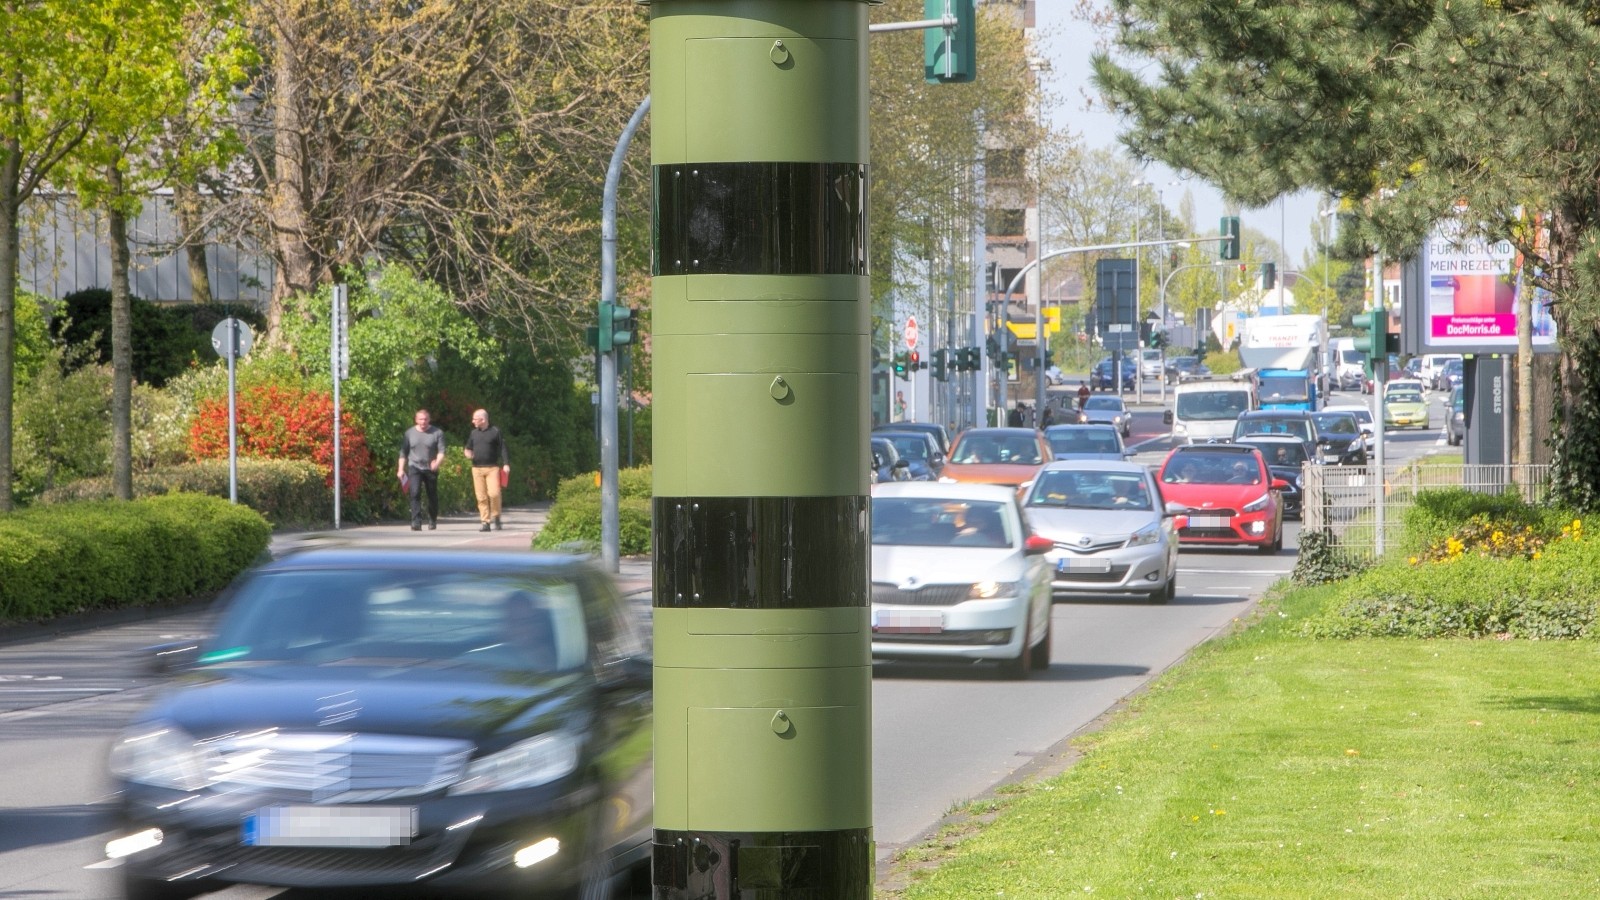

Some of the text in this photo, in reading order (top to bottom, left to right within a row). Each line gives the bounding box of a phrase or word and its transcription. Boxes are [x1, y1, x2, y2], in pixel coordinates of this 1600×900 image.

[1430, 241, 1453, 255] FÜR
[1487, 242, 1510, 255] UND
[1430, 260, 1458, 271] MEIN
[1447, 324, 1501, 334] DocMorris.de
[1493, 375, 1502, 414] STRÖER
